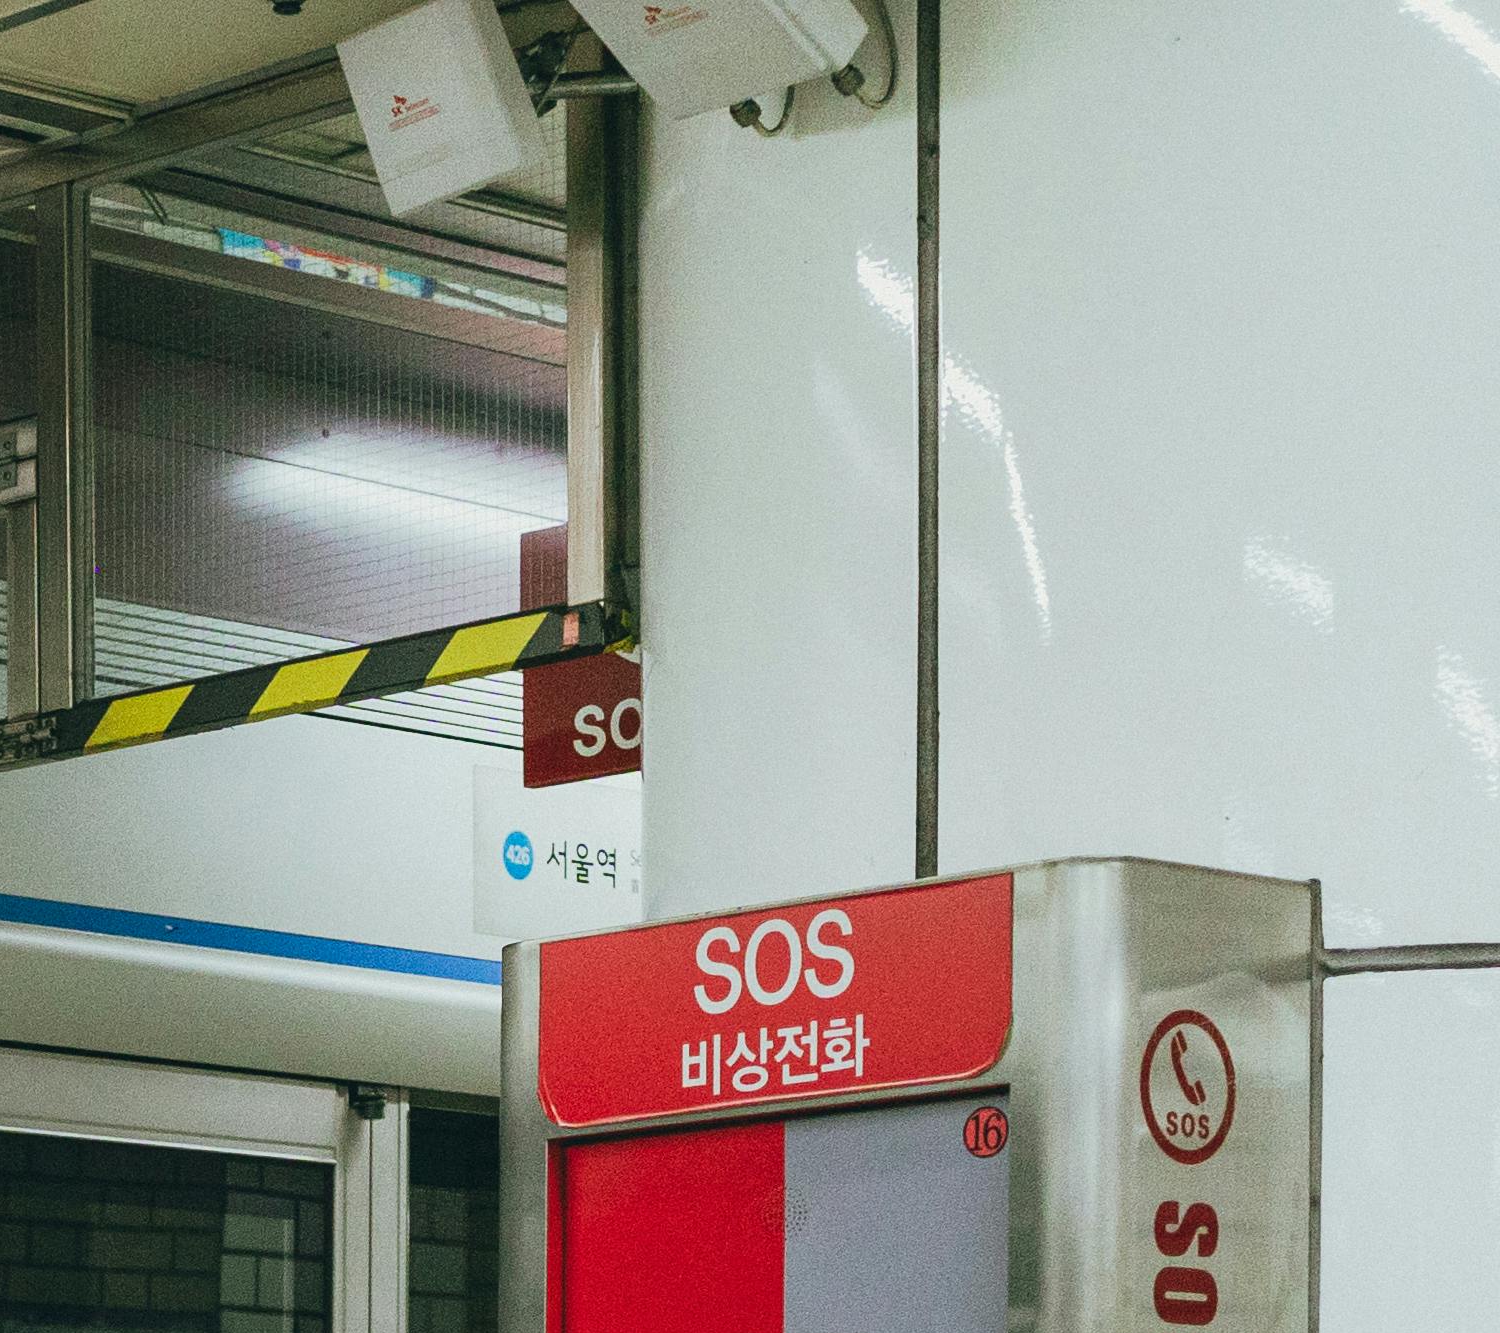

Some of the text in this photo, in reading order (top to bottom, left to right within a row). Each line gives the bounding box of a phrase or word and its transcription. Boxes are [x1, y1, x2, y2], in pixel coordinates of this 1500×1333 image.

[547, 840, 616, 888] 서울역
[693, 908, 855, 1015] SOS
[682, 1015, 871, 1097] 비상전화
[972, 1111, 1004, 1153] 16
[1165, 1111, 1211, 1140] SOS
